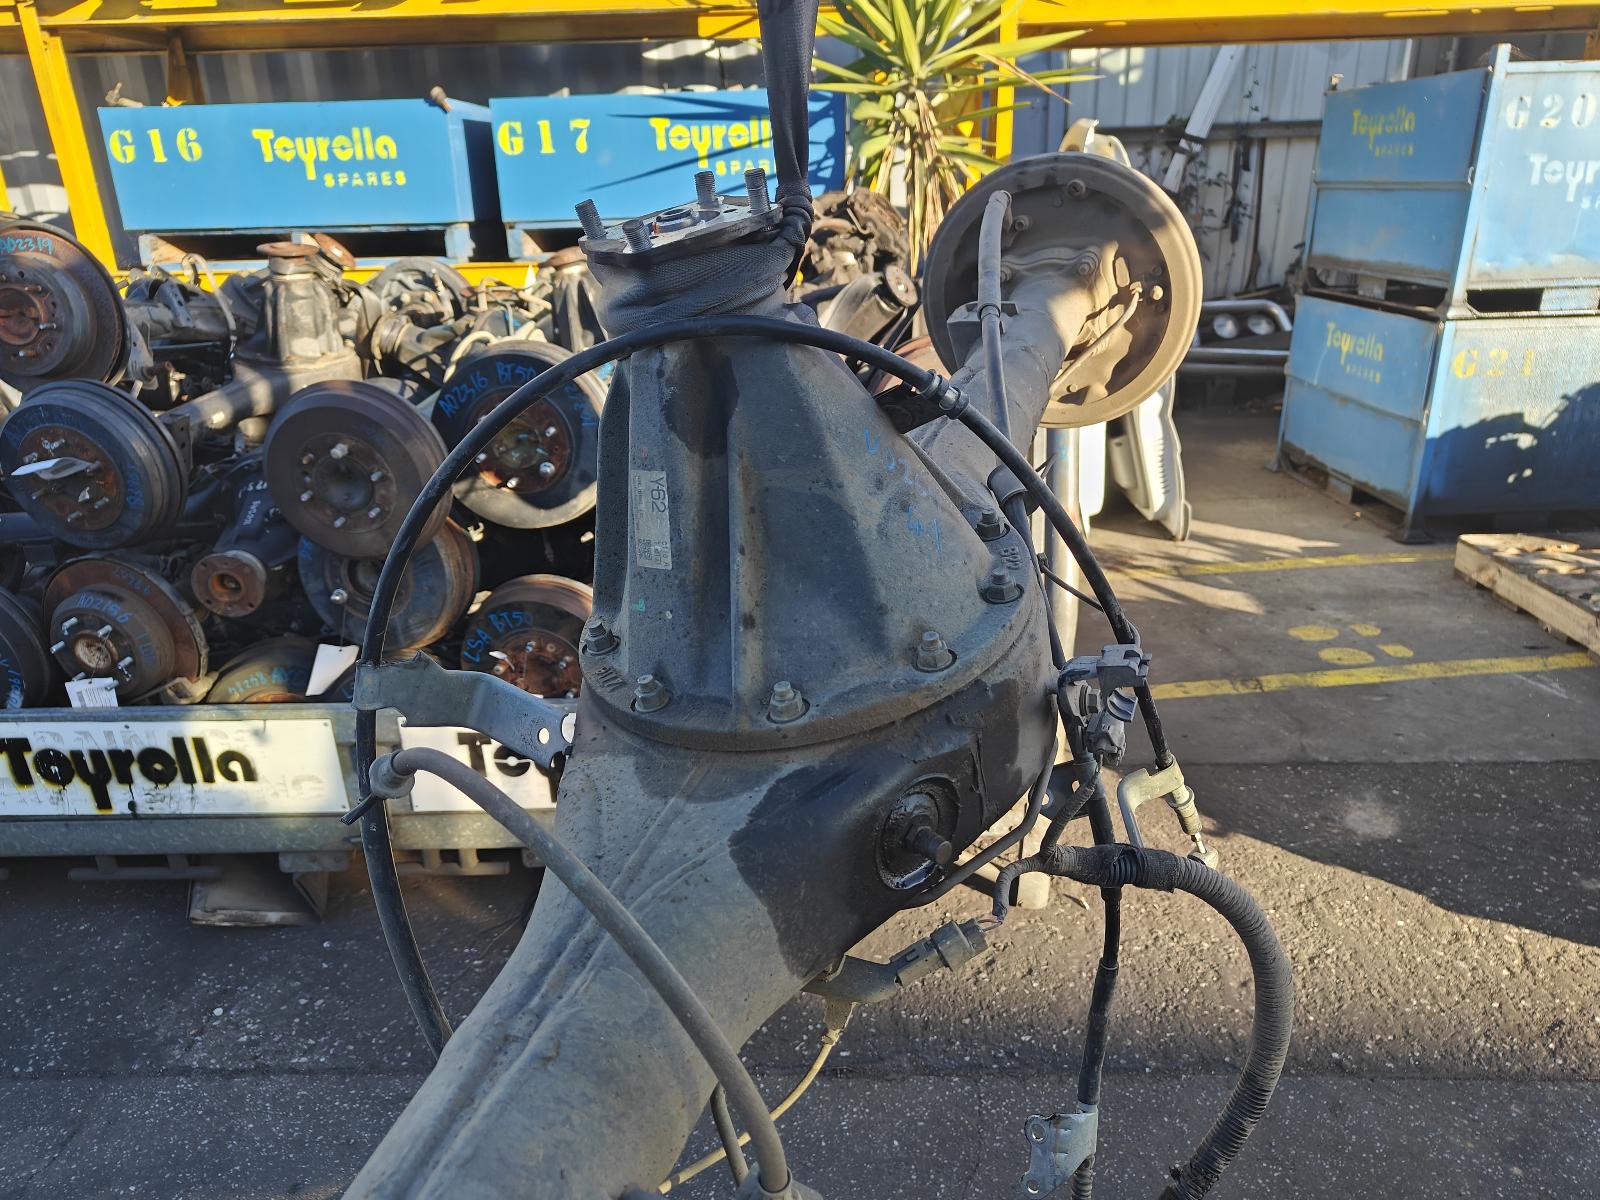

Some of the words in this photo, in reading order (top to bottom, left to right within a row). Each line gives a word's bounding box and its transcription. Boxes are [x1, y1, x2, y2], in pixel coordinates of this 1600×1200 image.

[109, 128, 203, 164] G16
[497, 118, 592, 156] G17
[324, 170, 407, 188] SPARES
[1, 737, 258, 811] Toyrolla
